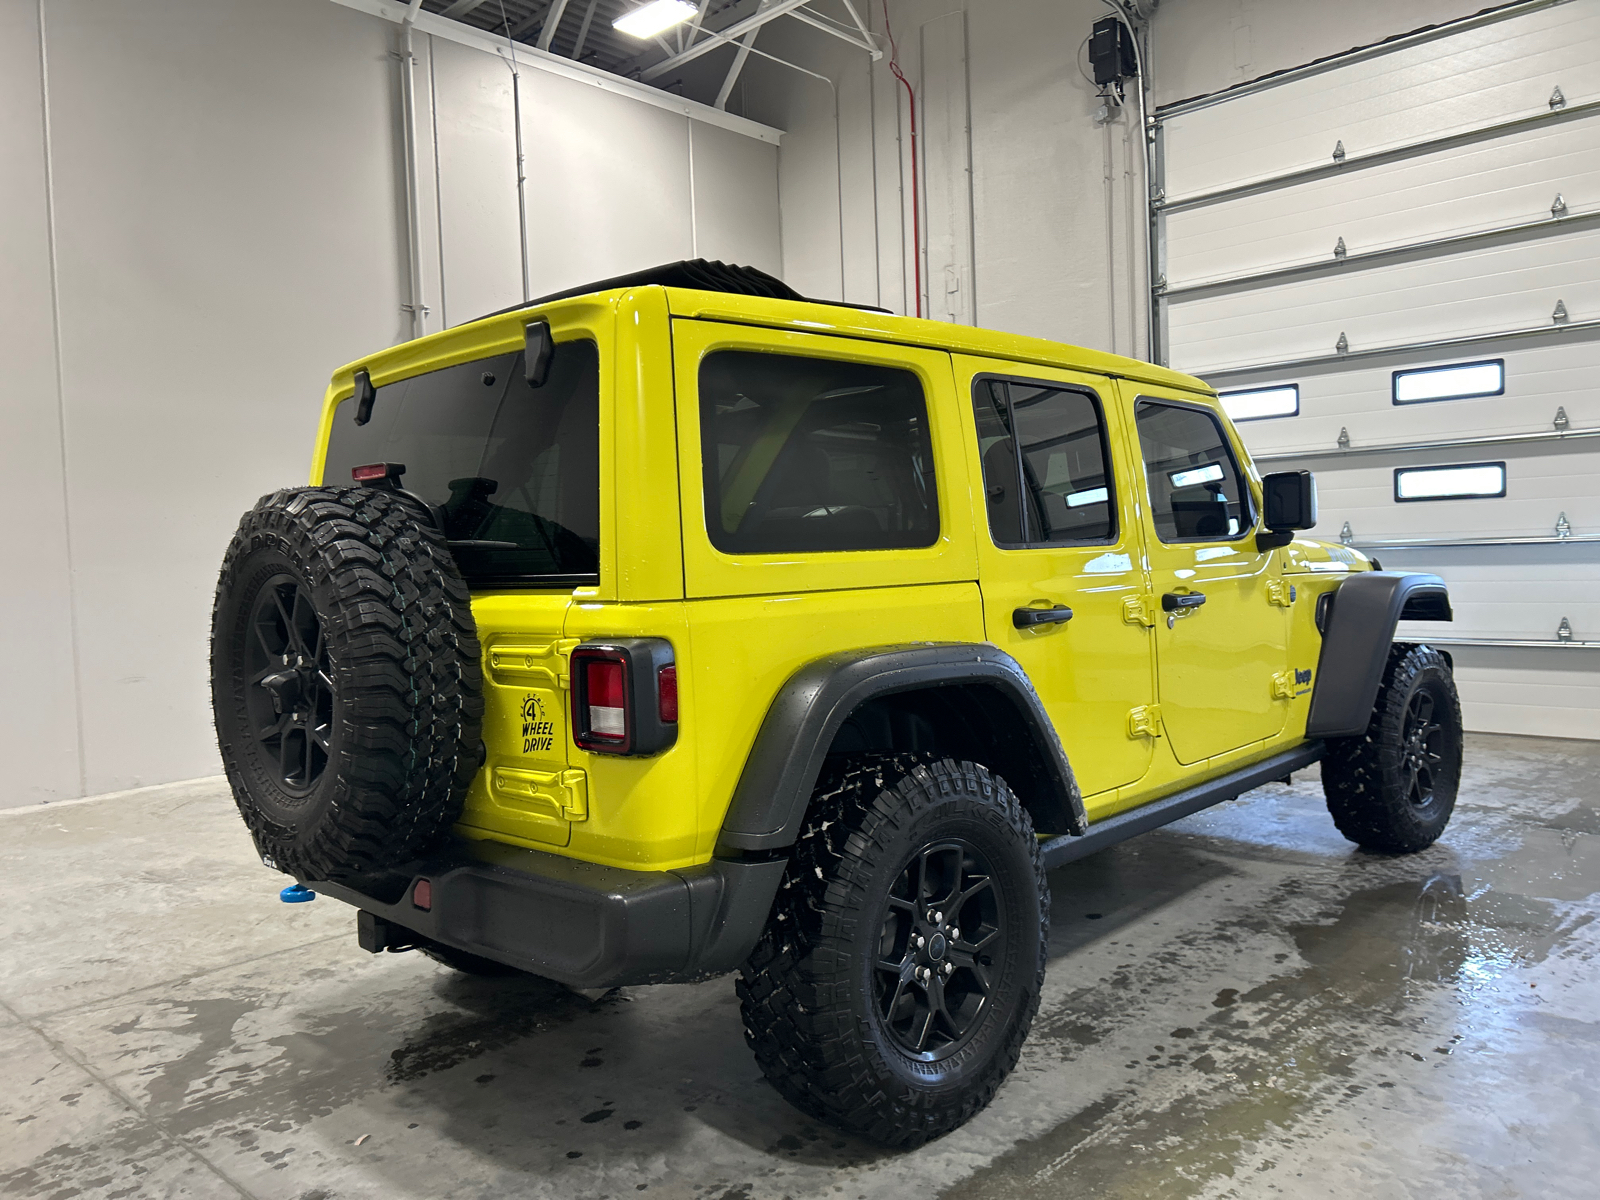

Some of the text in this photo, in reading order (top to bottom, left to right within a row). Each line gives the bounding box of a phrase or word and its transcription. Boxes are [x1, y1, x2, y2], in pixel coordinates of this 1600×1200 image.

[526, 702, 536, 721] 4
[522, 722, 553, 737] WHEEL
[523, 737, 553, 754] DRIVE
